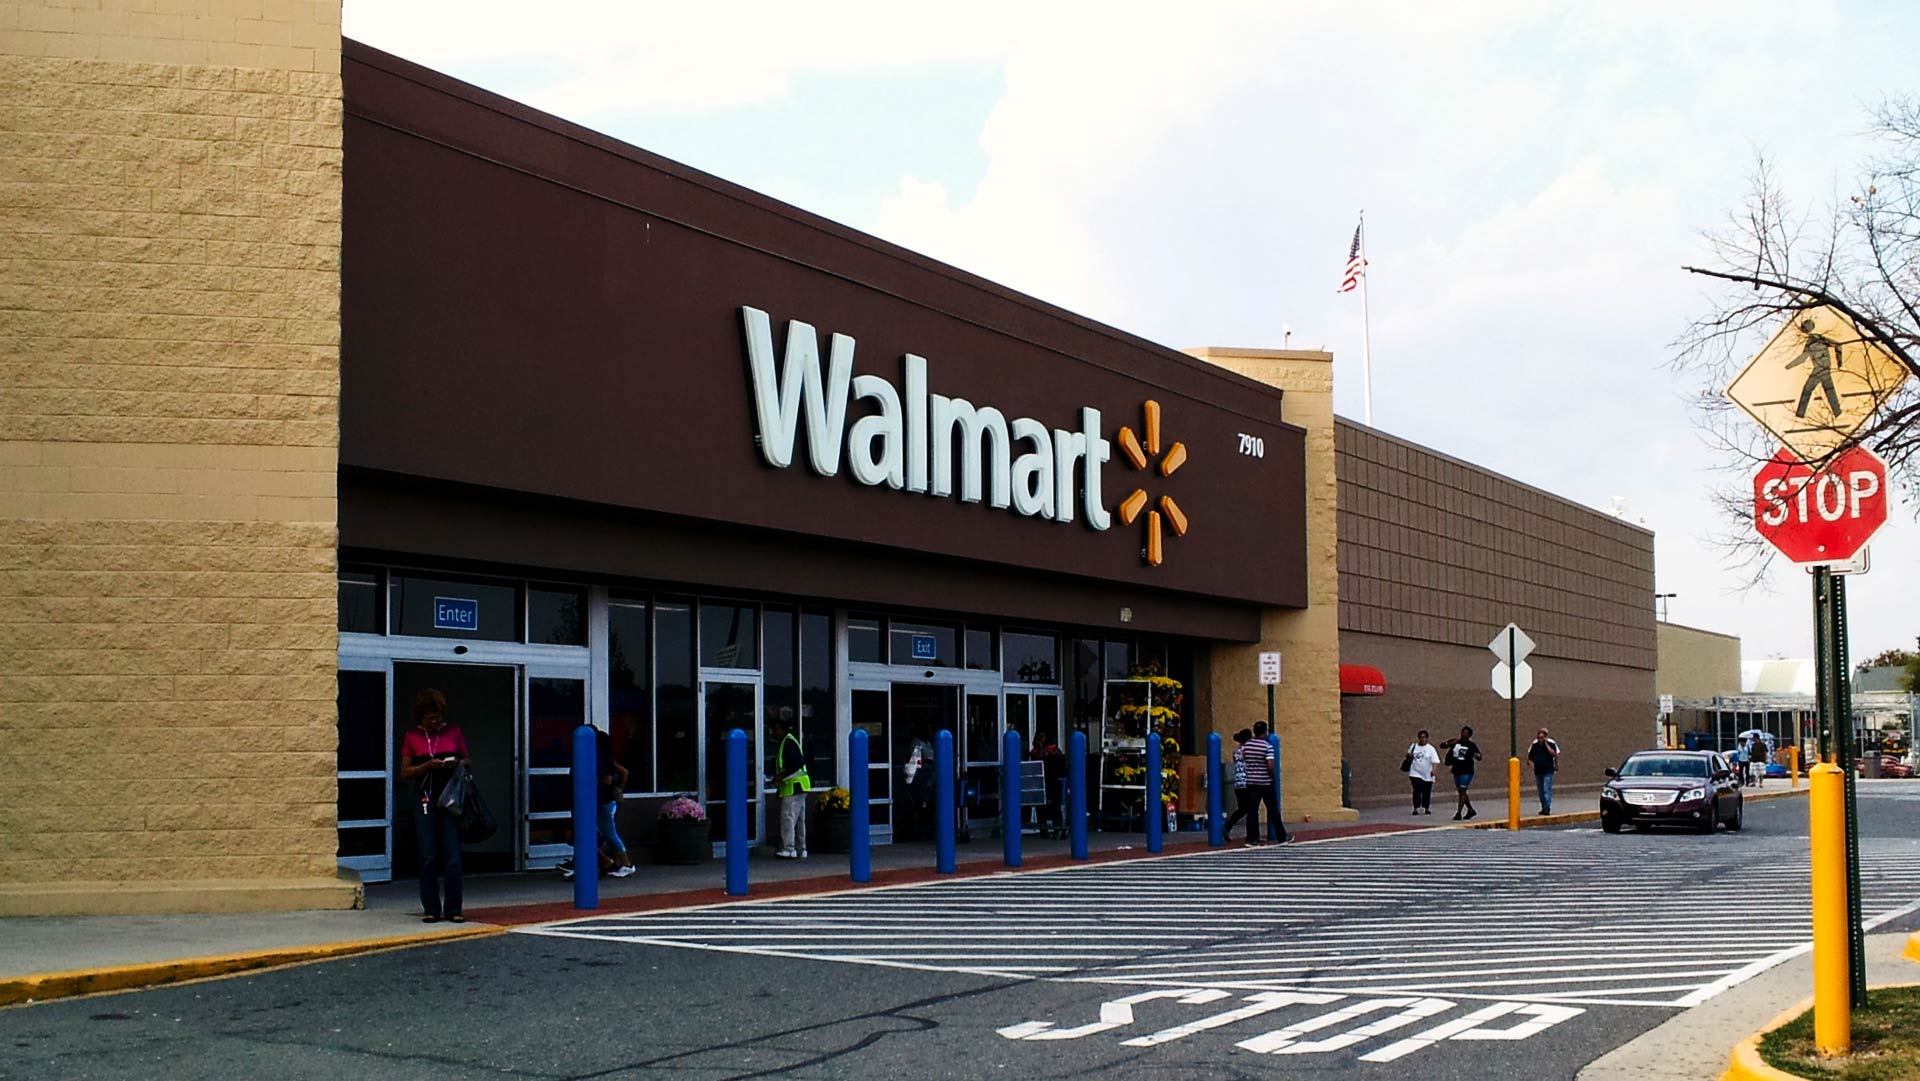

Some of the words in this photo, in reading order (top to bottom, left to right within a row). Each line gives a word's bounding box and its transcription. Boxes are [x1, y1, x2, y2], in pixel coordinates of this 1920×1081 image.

[742, 305, 1111, 531] Walmart
[1238, 432, 1264, 458] 7910
[1762, 471, 1879, 526] STOP
[439, 604, 472, 622] Enter
[917, 640, 931, 654] Exit
[995, 988, 1586, 1063] STOP
